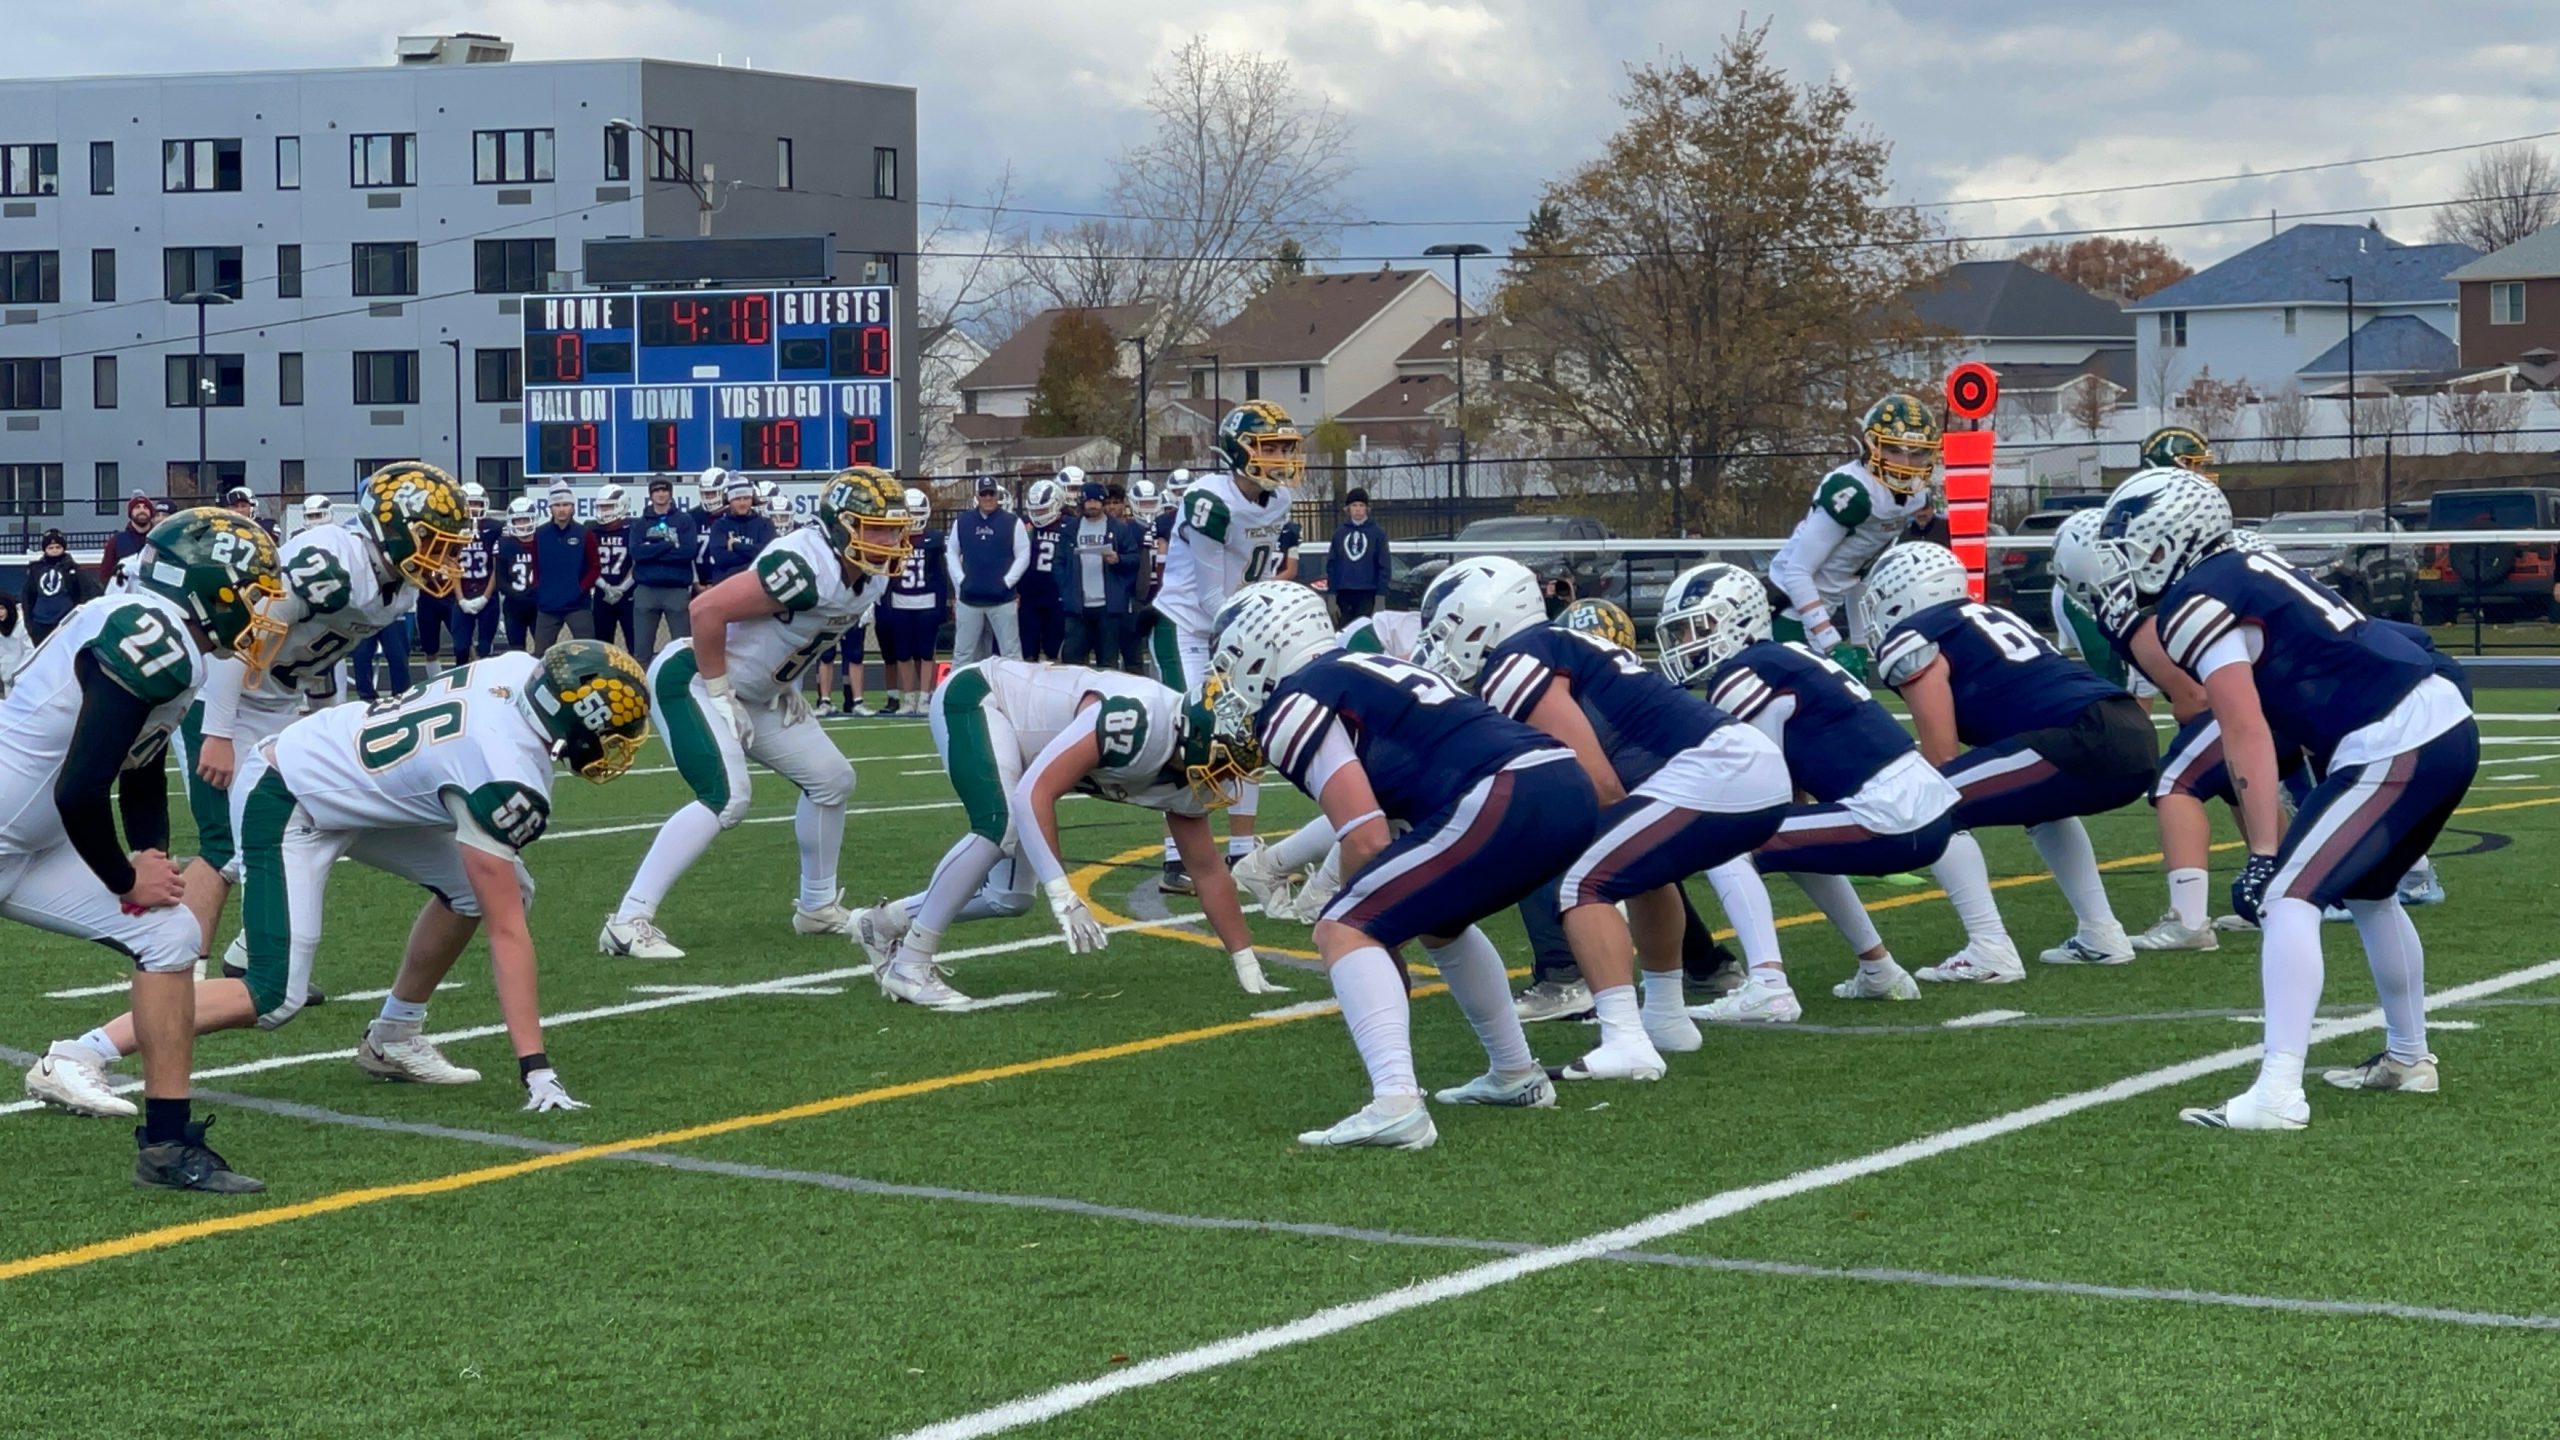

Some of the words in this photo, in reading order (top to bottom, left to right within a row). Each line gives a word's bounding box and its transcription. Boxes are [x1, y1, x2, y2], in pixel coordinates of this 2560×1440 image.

[545, 298, 613, 330] HOME
[673, 295, 769, 344] 4:10
[784, 291, 881, 325] GUESTS
[556, 333, 581, 381] 0
[863, 326, 888, 375] 0
[531, 390, 574, 422] BALL
[580, 389, 607, 421] ON
[632, 388, 693, 420] DOWN
[720, 387, 759, 417] YDS
[765, 386, 788, 416] TO
[799, 386, 820, 417] GO
[842, 385, 881, 416] QTR
[572, 423, 595, 471] 8
[665, 424, 675, 467] 1
[761, 420, 798, 468] 10
[850, 418, 875, 466] 2
[1192, 498, 1214, 527] 9
[211, 532, 256, 572] 27
[1037, 531, 1061, 542] LAKE
[598, 547, 628, 575] 27
[901, 559, 926, 589] 51
[1036, 541, 1055, 572] 2
[290, 553, 342, 604] 24
[765, 559, 808, 603] 51
[1573, 605, 1599, 629] 55
[119, 612, 186, 678] 27
[573, 691, 613, 731] 56
